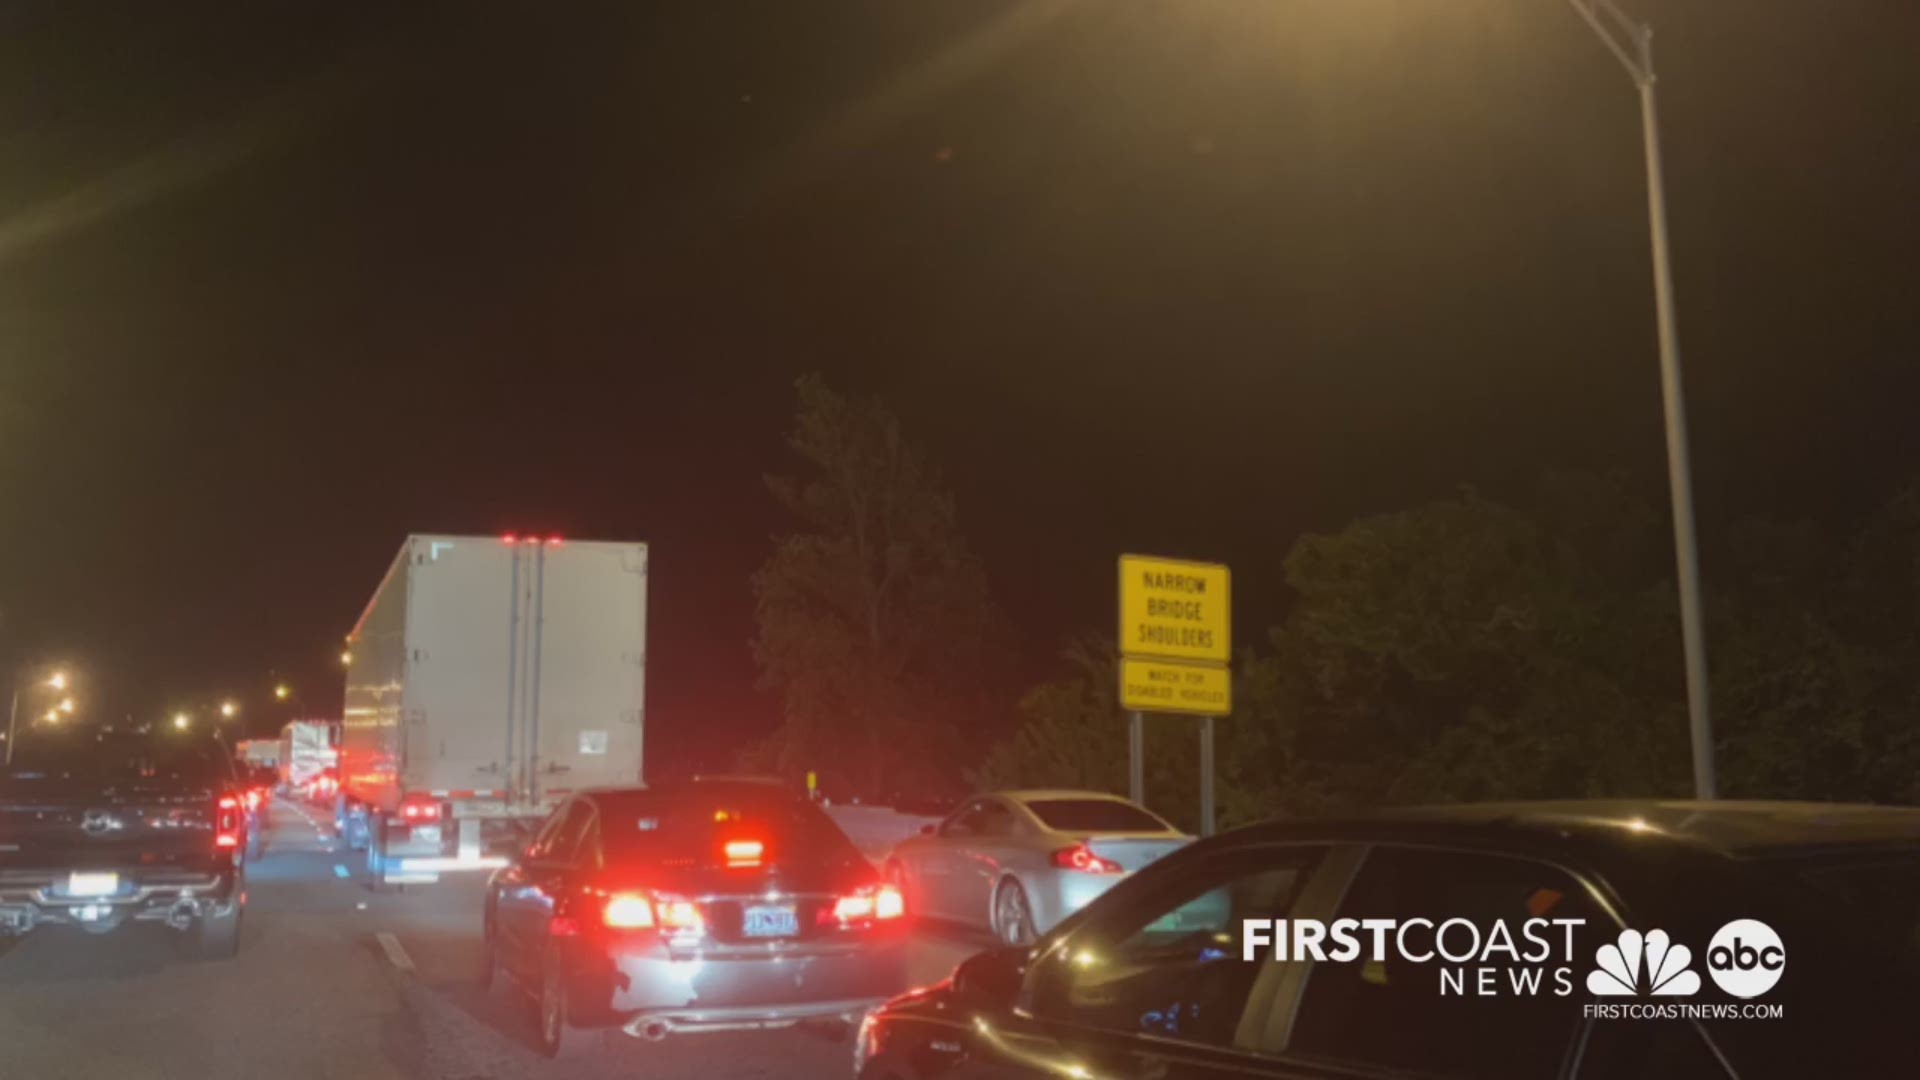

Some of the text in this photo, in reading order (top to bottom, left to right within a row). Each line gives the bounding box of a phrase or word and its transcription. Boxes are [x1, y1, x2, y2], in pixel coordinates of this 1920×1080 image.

[1142, 571, 1207, 594] NARROW
[1147, 597, 1203, 621] BRIDGE
[1138, 623, 1213, 649] SHOULDERS
